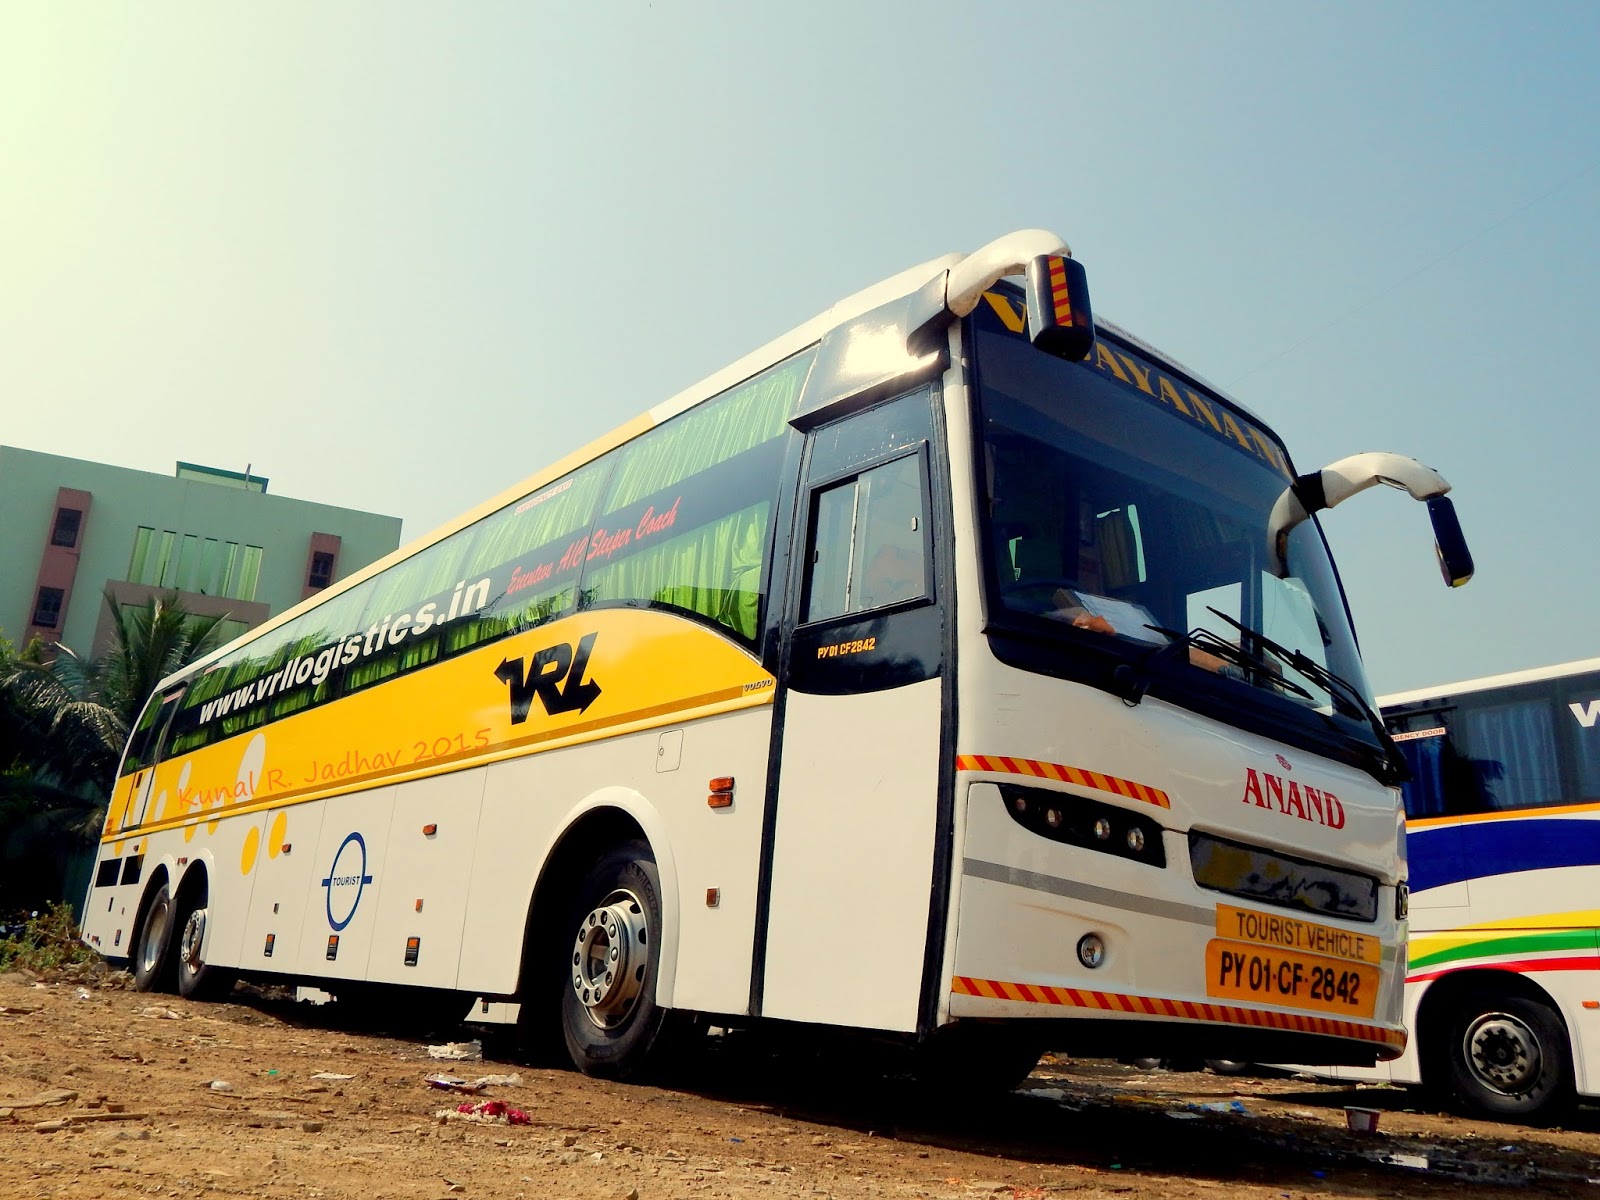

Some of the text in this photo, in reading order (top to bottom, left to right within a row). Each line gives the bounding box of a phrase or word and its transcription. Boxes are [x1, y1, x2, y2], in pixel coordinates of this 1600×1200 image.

[981, 290, 1279, 470] VAYANAN
[507, 565, 553, 595] Executive
[586, 528, 633, 560] Sleeper
[635, 496, 682, 540] Coach
[199, 577, 491, 725] www.vrllogistics.in
[494, 631, 602, 726] VRL
[744, 678, 773, 691] VOLVO
[1422, 728, 1444, 736] DOOR
[1243, 768, 1345, 830] ANAND
[333, 876, 360, 886] TOURIST
[1237, 912, 1364, 960] TOURIST VEHICLE
